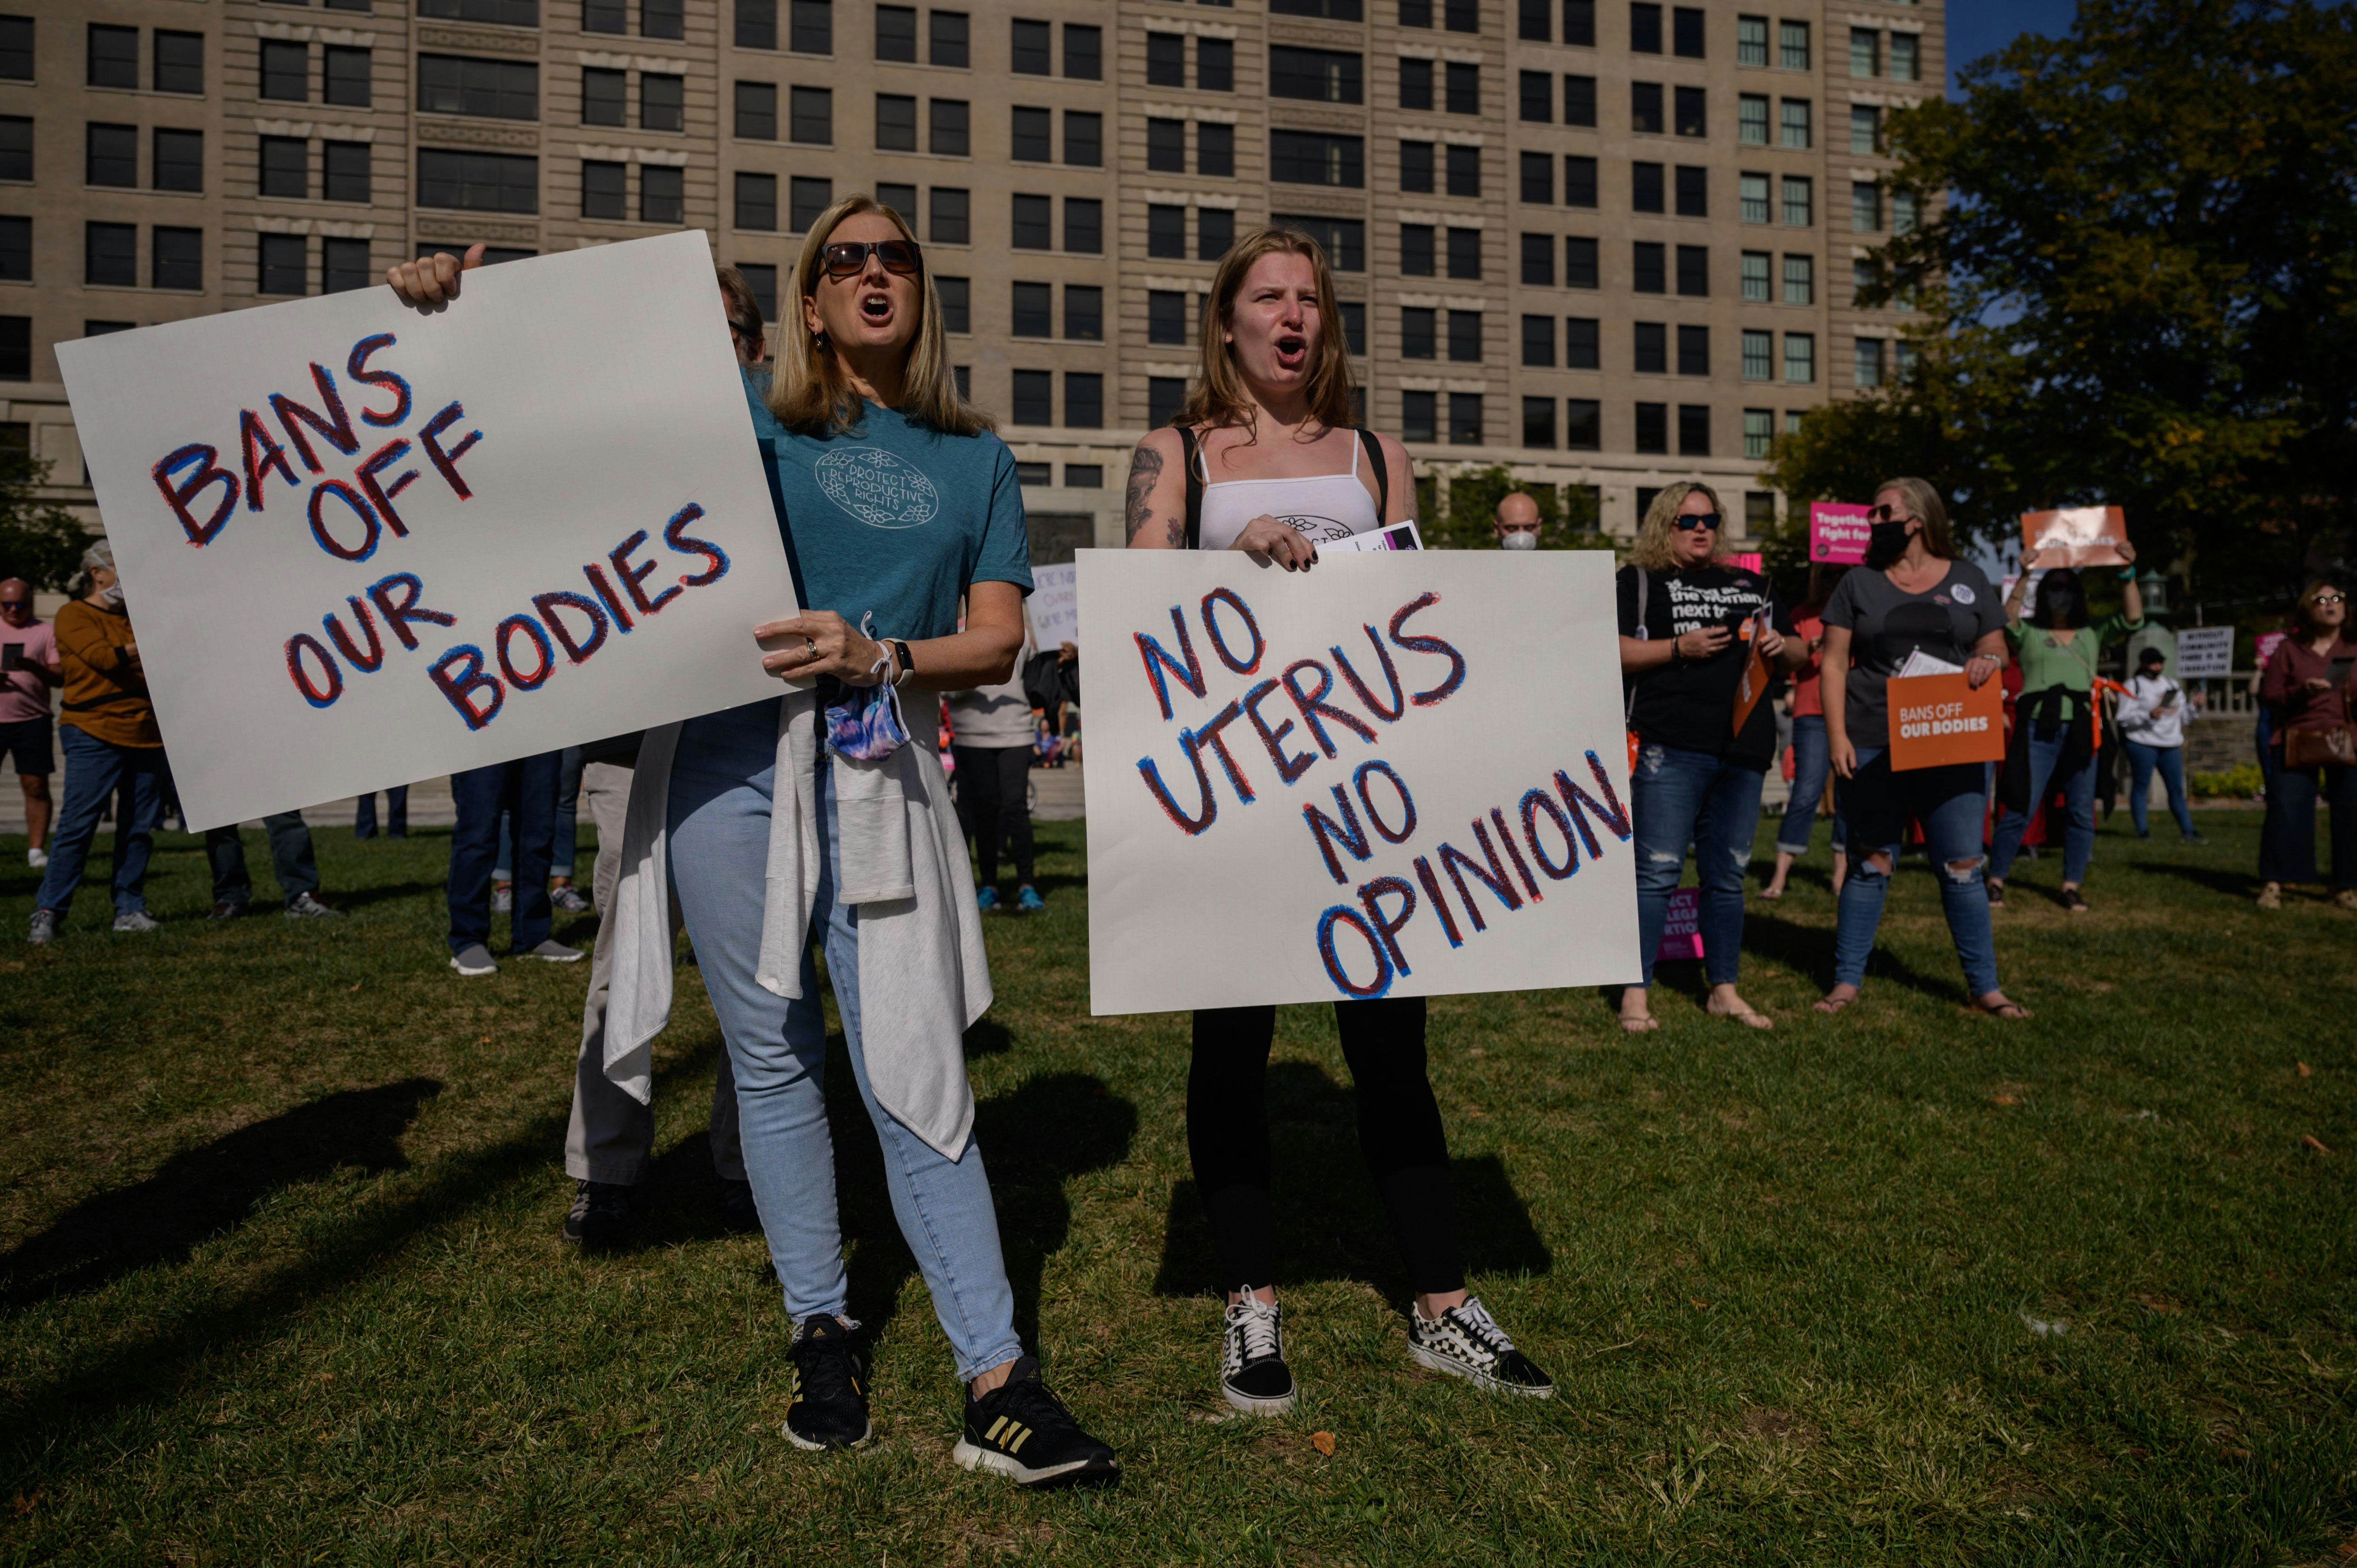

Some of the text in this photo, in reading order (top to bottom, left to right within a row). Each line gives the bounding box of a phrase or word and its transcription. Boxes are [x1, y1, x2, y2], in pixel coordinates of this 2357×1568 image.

[151, 332, 412, 548] BANS
[308, 401, 483, 562] OFF
[830, 468, 925, 504] REPRODUCTIVE
[850, 464, 906, 487] PROTECT
[855, 488, 899, 510] RIGHTS
[1819, 526, 1850, 542] Fight
[1670, 590, 1762, 605] the woman
[1672, 603, 1711, 619] next
[427, 503, 731, 731] BODIES
[1673, 621, 1702, 635] me
[284, 572, 457, 708] OUR
[1133, 587, 1267, 721] NO
[1136, 591, 1467, 836] UTERUS
[1899, 702, 1963, 723] BANS OFF
[1900, 715, 1988, 739] OUR BODIES
[1302, 759, 1417, 885] NO
[1316, 749, 1632, 999] OPINION
